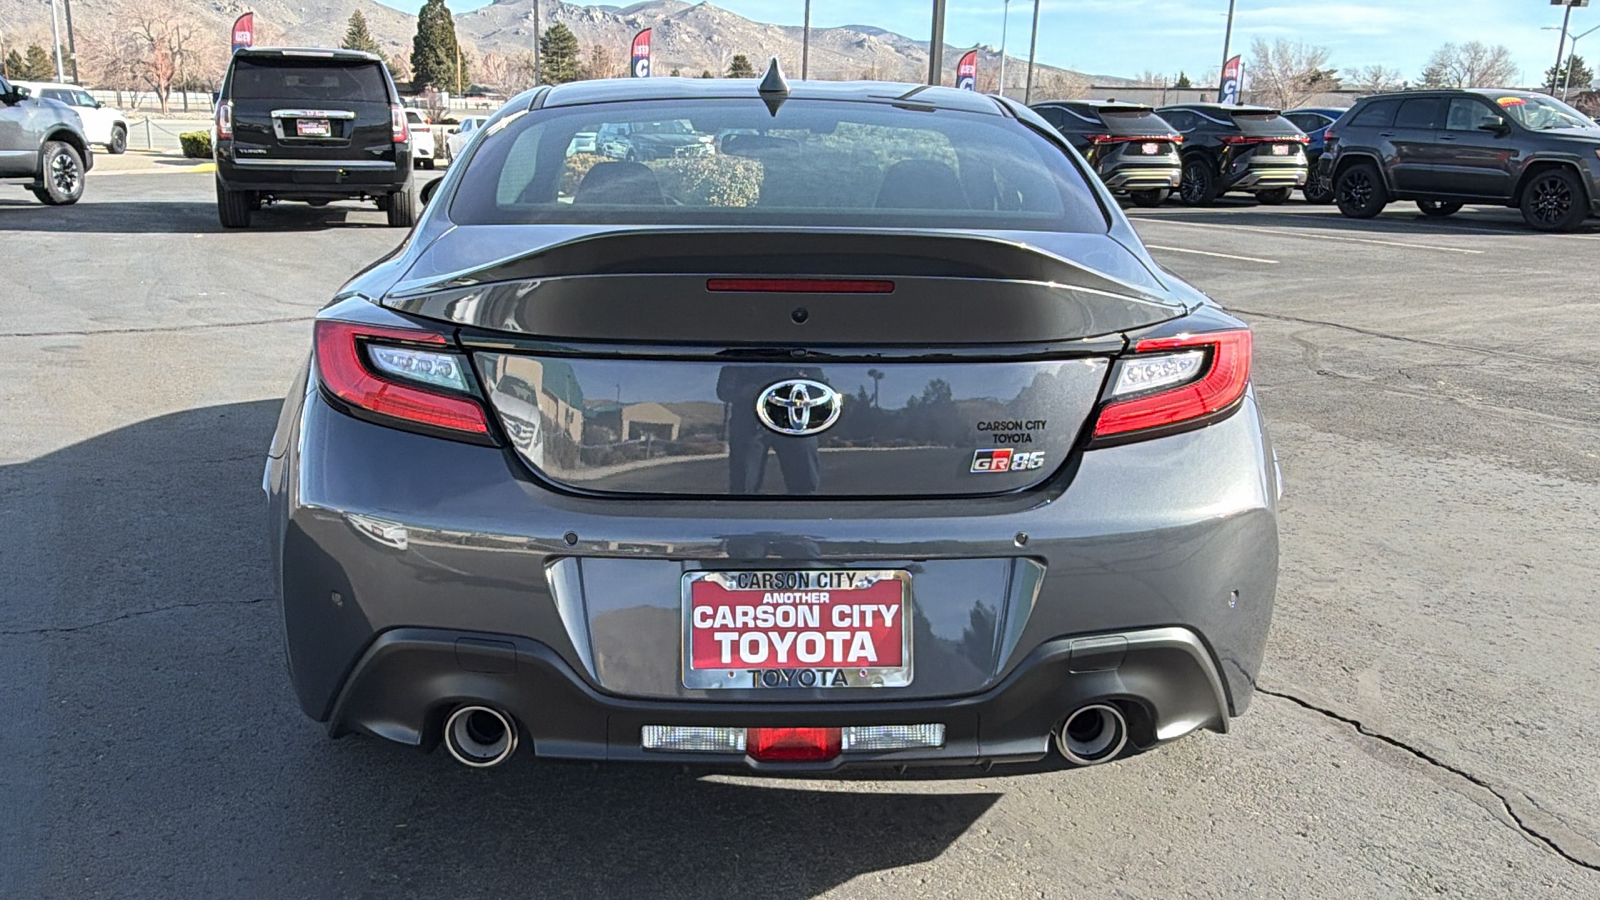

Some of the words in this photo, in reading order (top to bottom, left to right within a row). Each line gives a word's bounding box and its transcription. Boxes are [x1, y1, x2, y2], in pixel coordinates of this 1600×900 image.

[977, 421, 1022, 431] CARSON
[1025, 420, 1047, 430] CITY
[993, 433, 1032, 443] TOYOTA
[738, 572, 811, 589] CARSON
[817, 572, 857, 588] CITY
[762, 592, 829, 604] ANOTHER
[693, 605, 820, 628] CARSON
[832, 604, 899, 628] CITY
[713, 631, 878, 664] TOYOTA
[747, 669, 848, 688] TOYOTA
